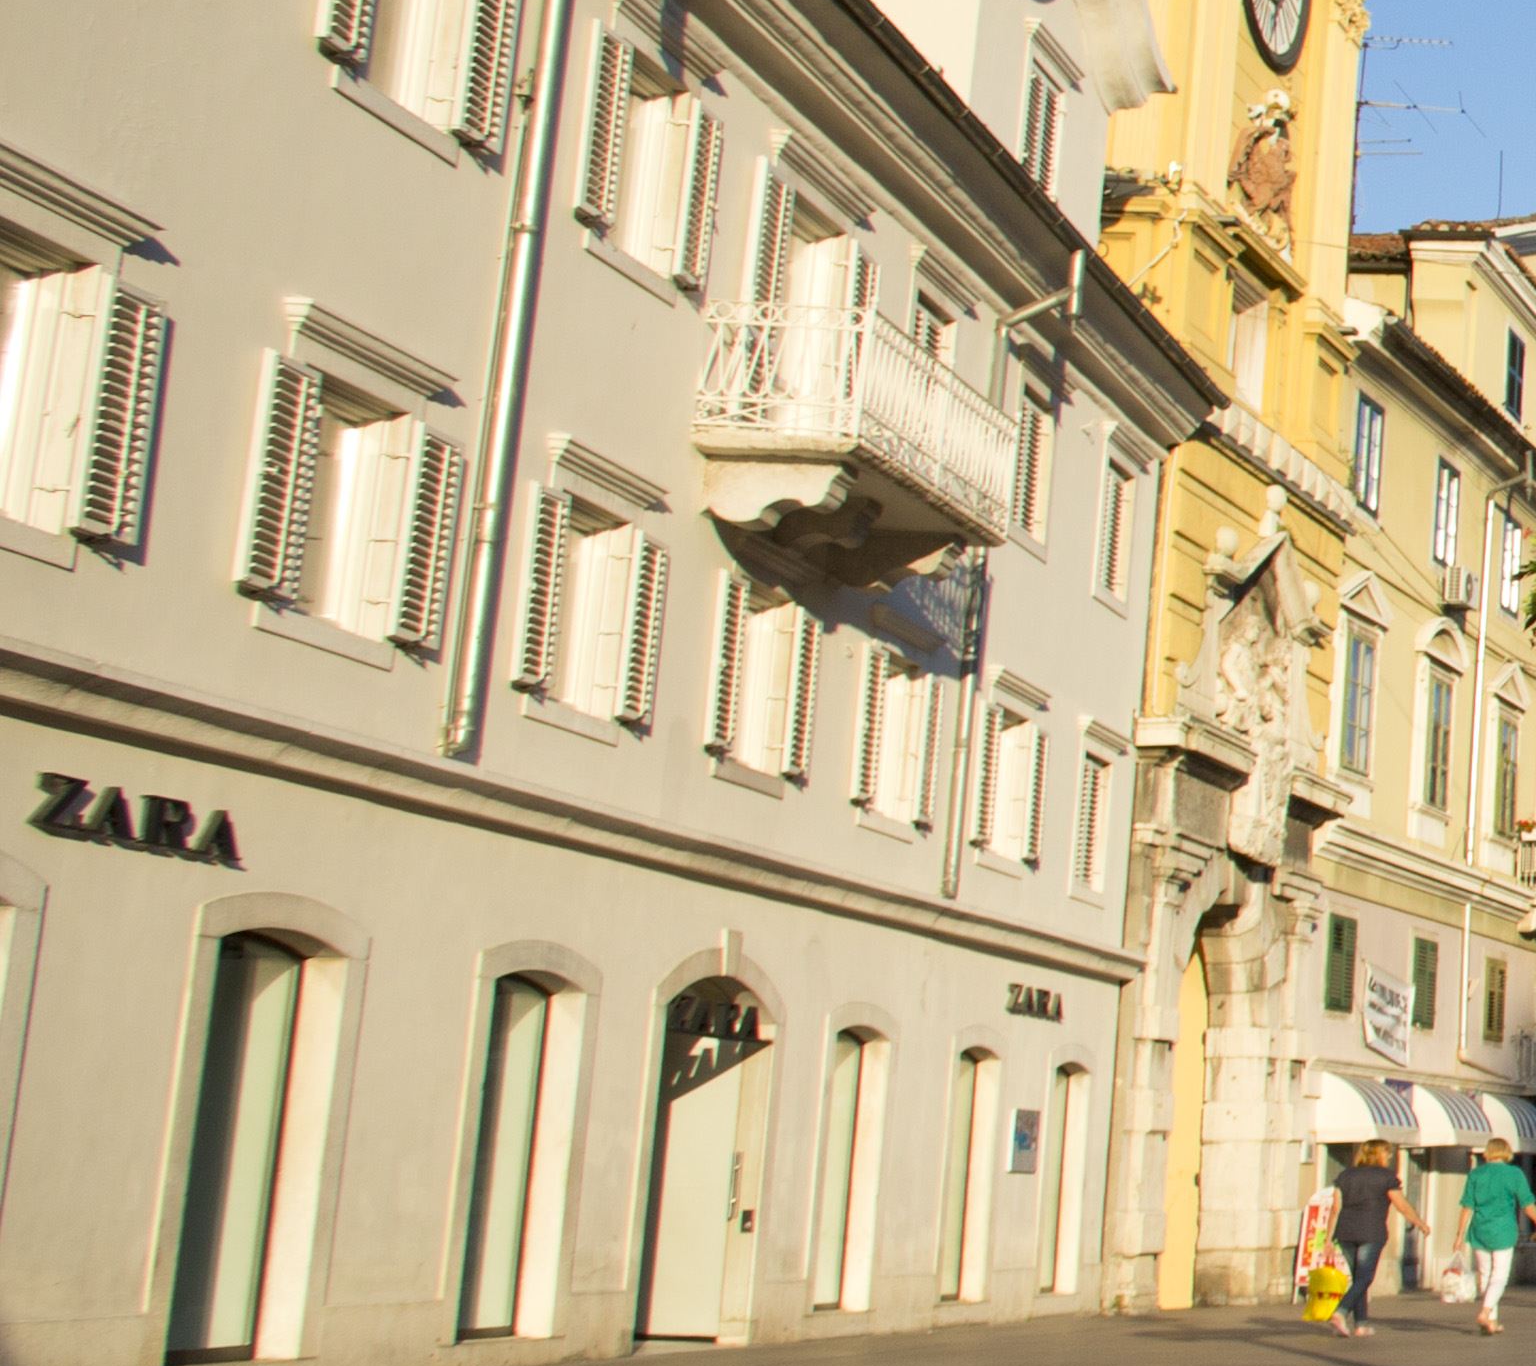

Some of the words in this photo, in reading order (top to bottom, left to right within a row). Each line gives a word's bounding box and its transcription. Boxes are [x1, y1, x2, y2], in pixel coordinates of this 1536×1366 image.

[26, 771, 247, 871] ZARA
[670, 993, 760, 1040] ZARA
[1006, 983, 1064, 1024] ZARA
